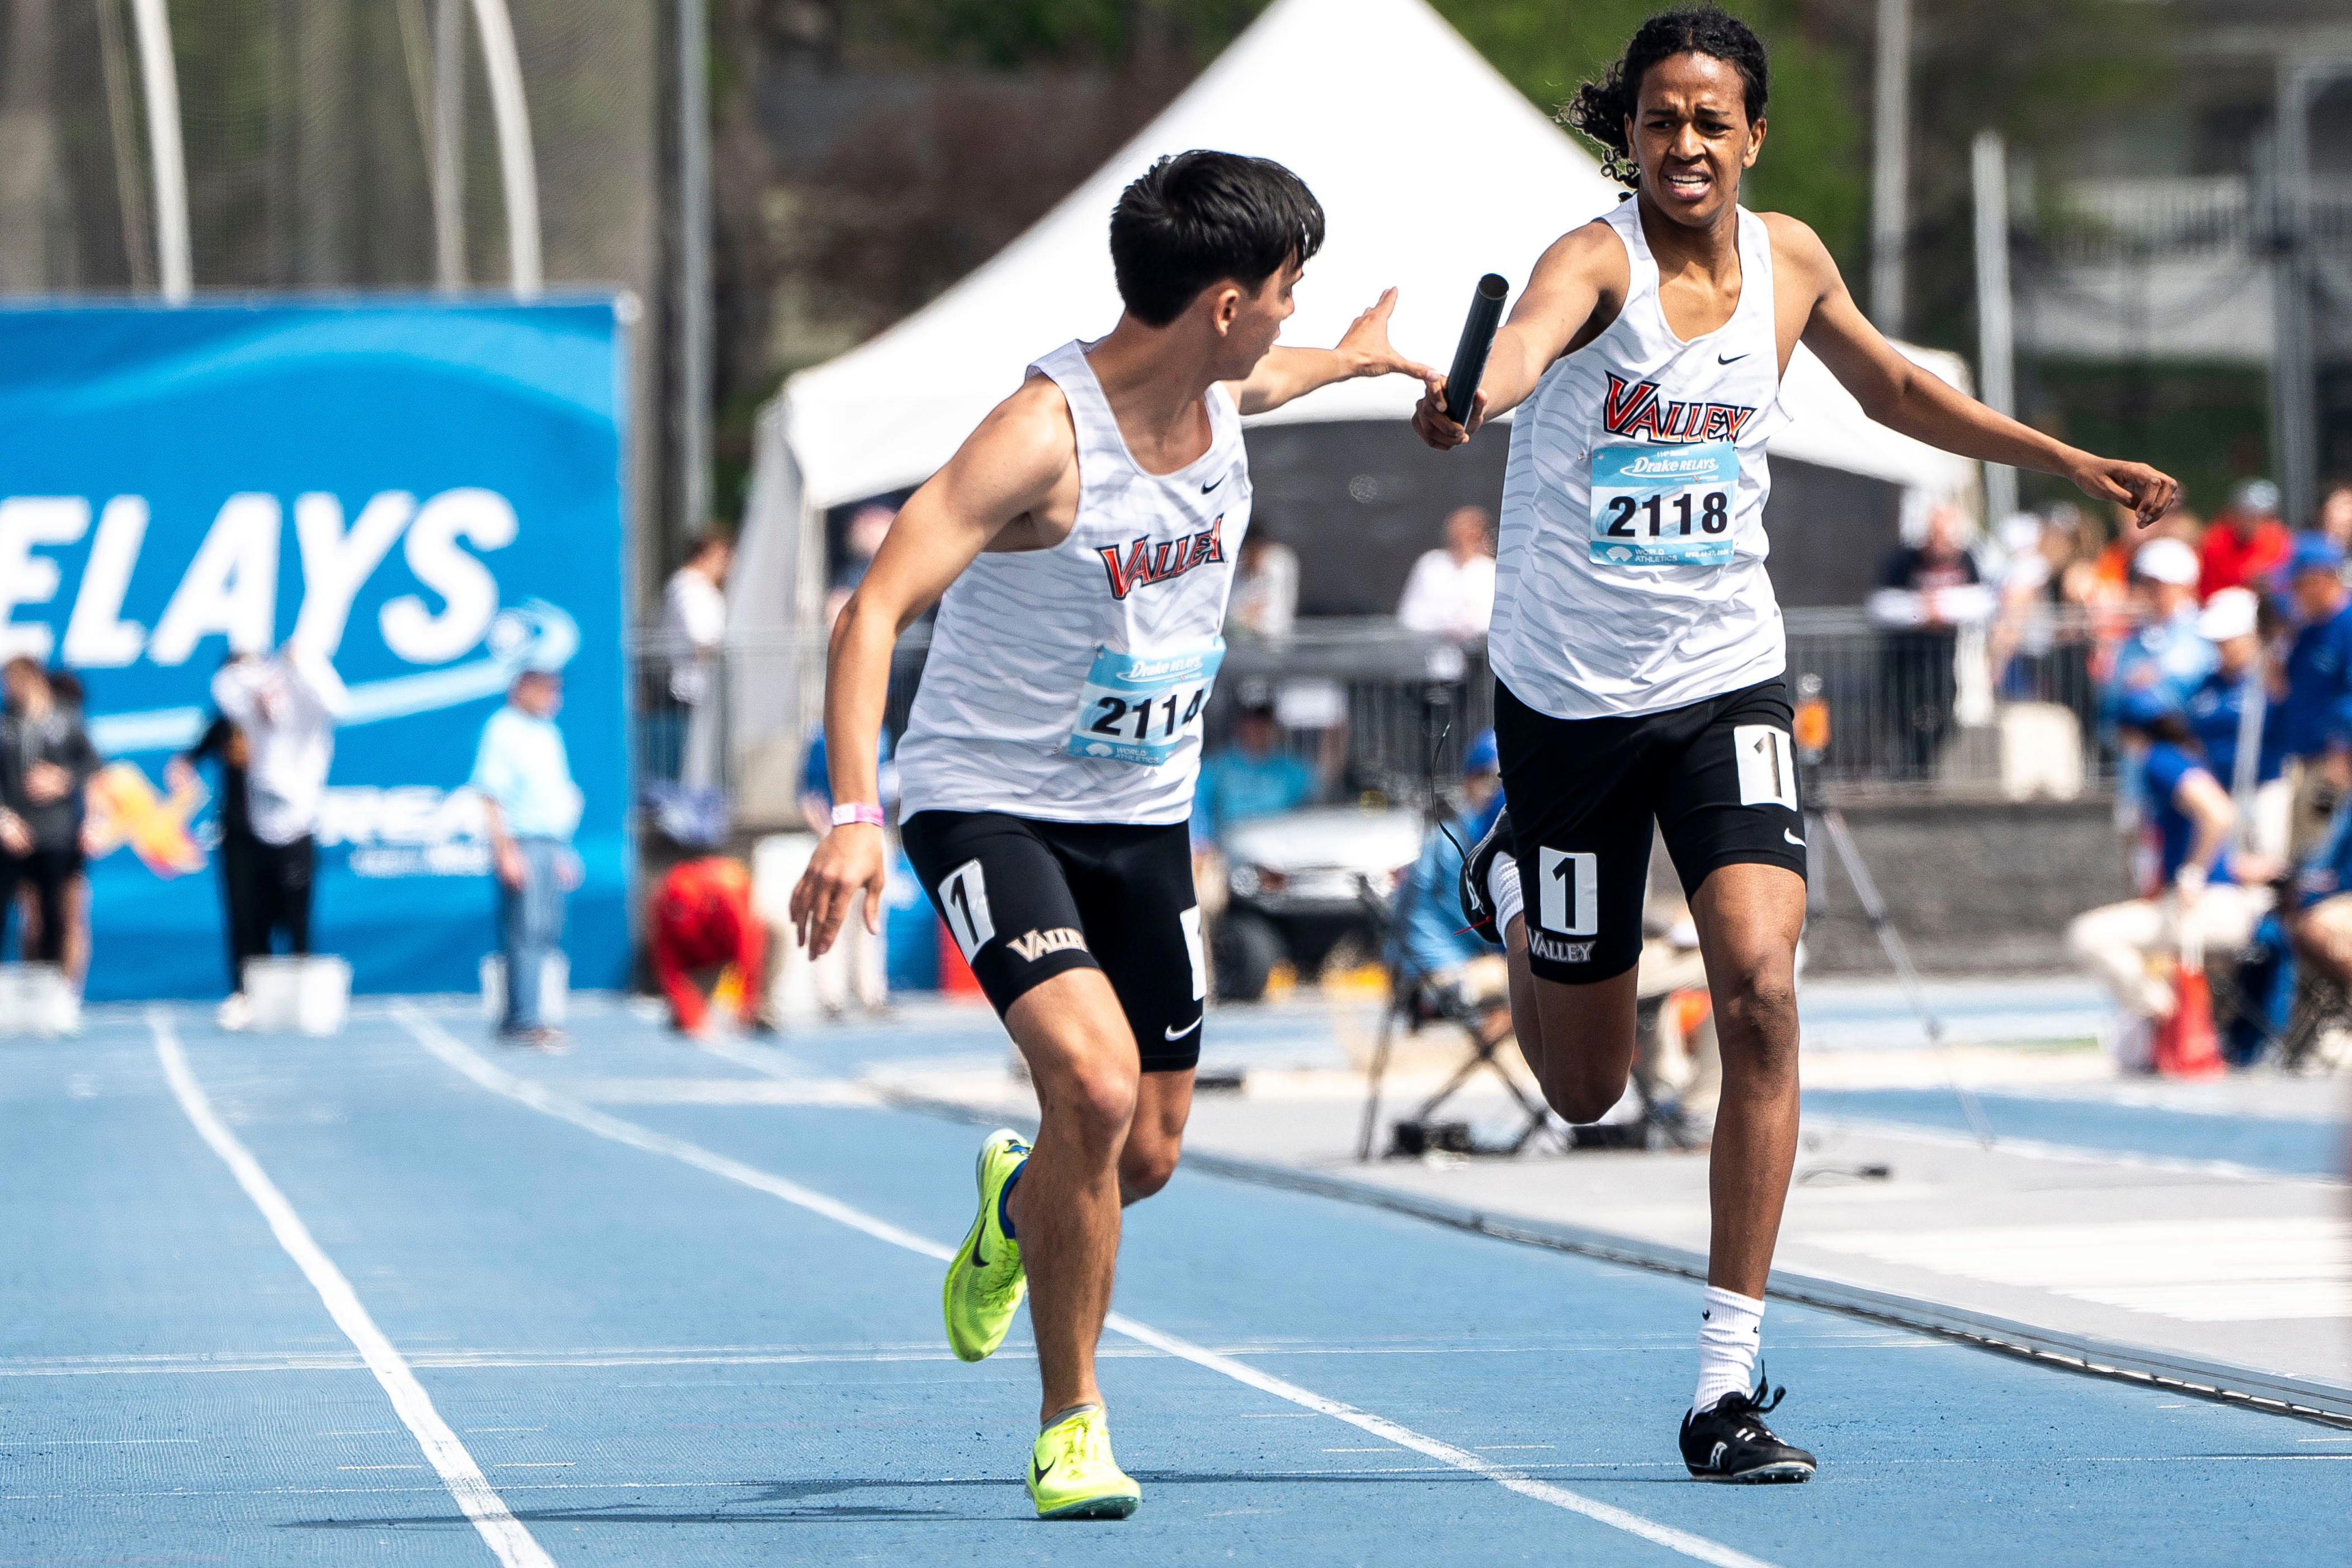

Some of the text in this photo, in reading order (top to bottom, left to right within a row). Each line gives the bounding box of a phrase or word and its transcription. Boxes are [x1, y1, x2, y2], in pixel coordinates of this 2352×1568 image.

[1604, 370, 1757, 444] VALLEY
[1632, 456, 1716, 473] Drake RELAYS
[1607, 492, 1728, 537] 2118
[1091, 688, 1204, 739] 2114
[1754, 731, 1782, 799] 1
[950, 873, 980, 947] 1
[1552, 856, 1576, 930] 1
[1526, 924, 1597, 964] VALLEY
